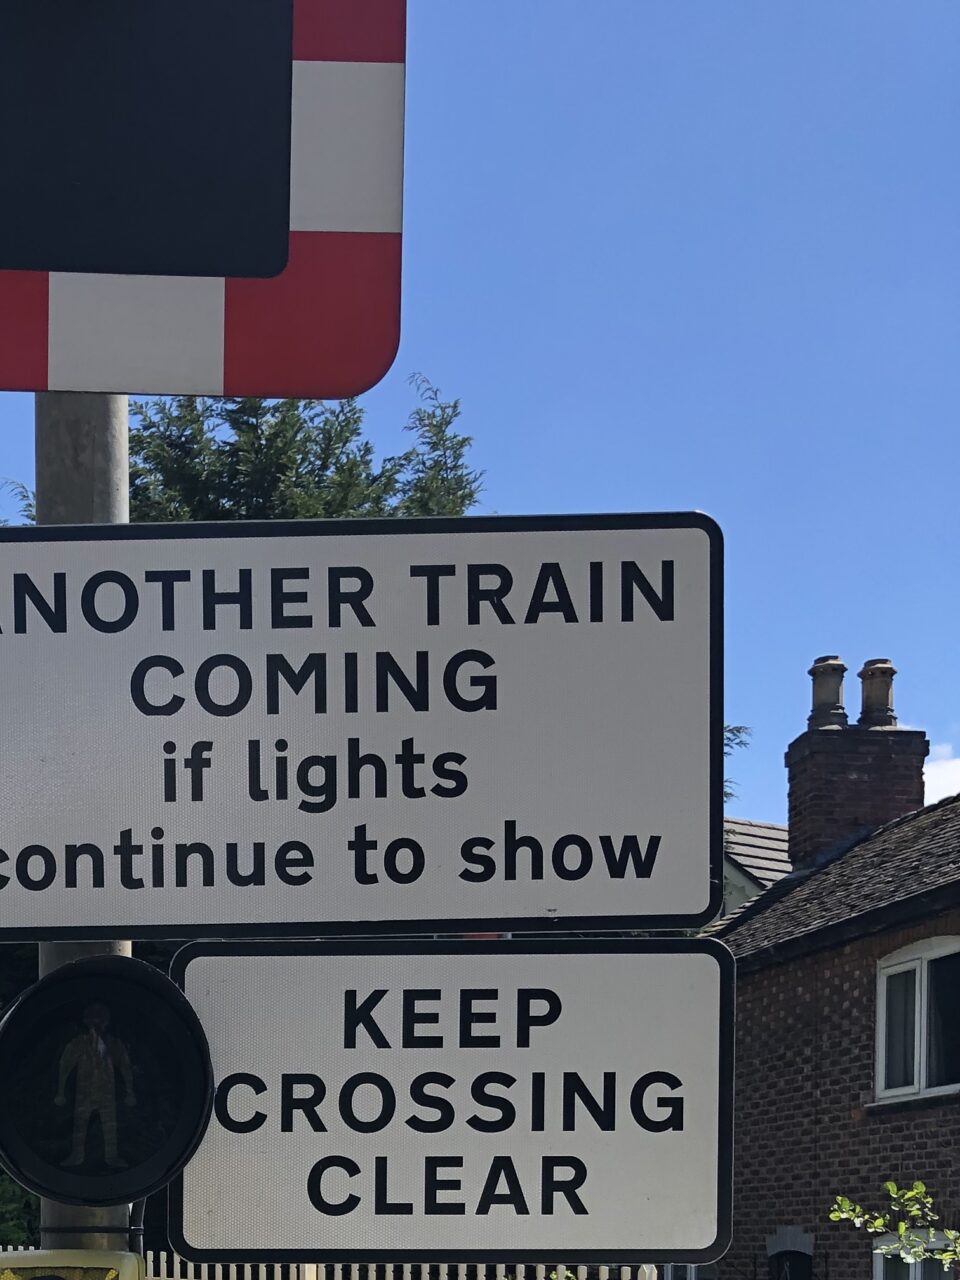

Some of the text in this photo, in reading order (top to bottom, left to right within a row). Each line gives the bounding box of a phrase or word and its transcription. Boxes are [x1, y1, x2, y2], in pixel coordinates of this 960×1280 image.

[410, 560, 674, 625] TRAIN
[131, 649, 497, 716] COMING
[163, 737, 468, 813] if lights
[348, 824, 425, 885] to
[459, 820, 661, 882] show
[344, 989, 562, 1048] KEEP
[215, 1071, 683, 1133] CROSSING
[307, 1155, 588, 1216] CLEAR
